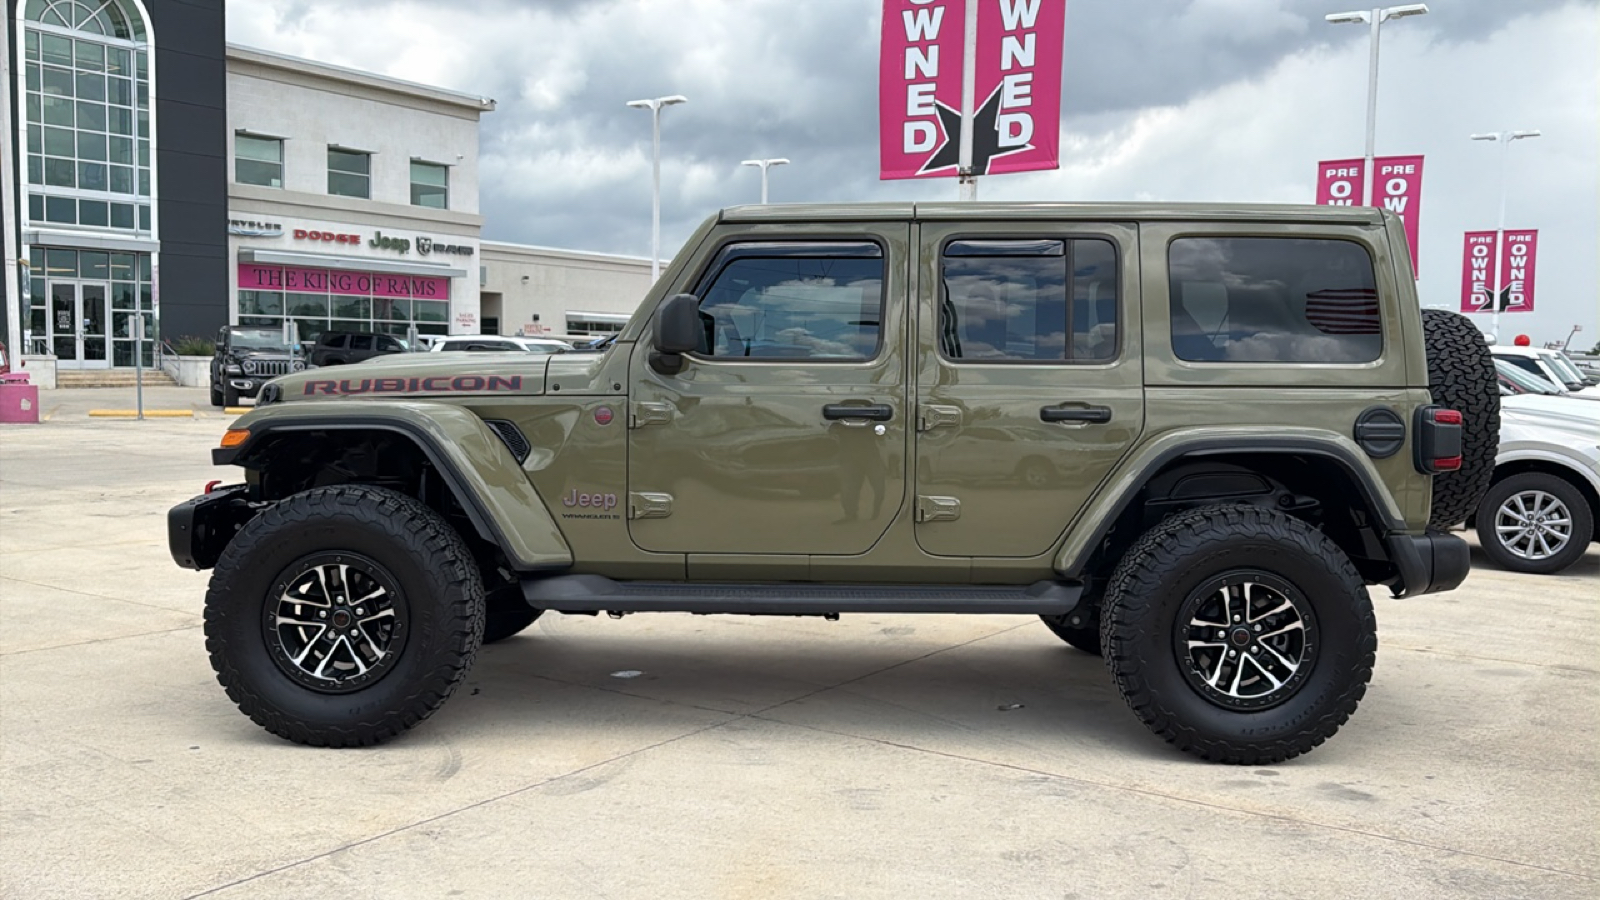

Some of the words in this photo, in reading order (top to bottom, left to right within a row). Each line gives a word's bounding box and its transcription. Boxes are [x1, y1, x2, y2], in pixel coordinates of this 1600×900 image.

[902, 0, 945, 154] WNED
[1325, 167, 1359, 178] PRE
[1381, 164, 1415, 175] PRE
[293, 228, 361, 245] DODGE
[368, 230, 411, 255] Jeep
[1469, 236, 1493, 244] PRE
[1508, 234, 1532, 242] PRE
[433, 243, 474, 256] RAM
[253, 268, 298, 288] THE
[303, 272, 351, 292] KING
[357, 276, 382, 293] OF
[387, 278, 437, 297] RAMS
[1470, 244, 1489, 305] OWNED
[1509, 243, 1528, 305] OWNED
[303, 375, 522, 395] RUBICON
[562, 488, 618, 511] Jeep
